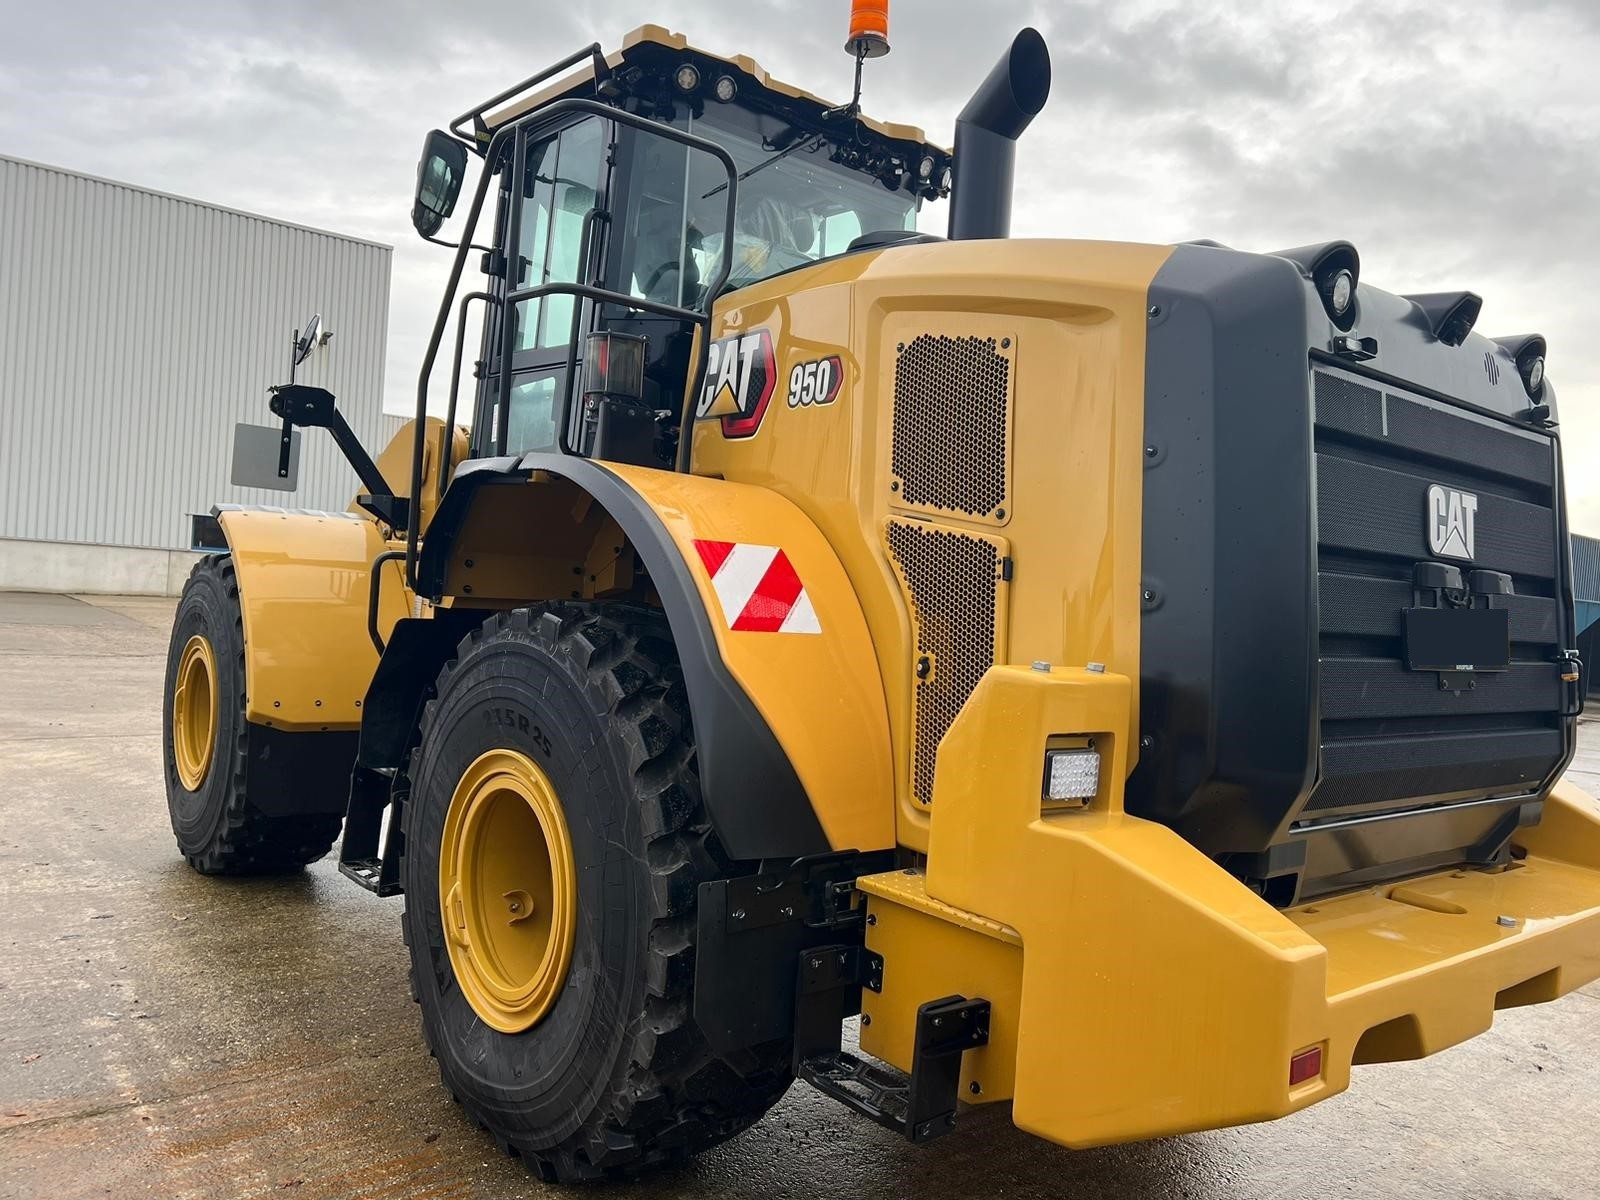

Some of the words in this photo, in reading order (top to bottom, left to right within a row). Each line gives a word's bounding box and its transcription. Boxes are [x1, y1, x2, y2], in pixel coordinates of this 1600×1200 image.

[696, 334, 760, 417] CAT
[788, 360, 831, 406] 950
[1429, 486, 1478, 560] CAT
